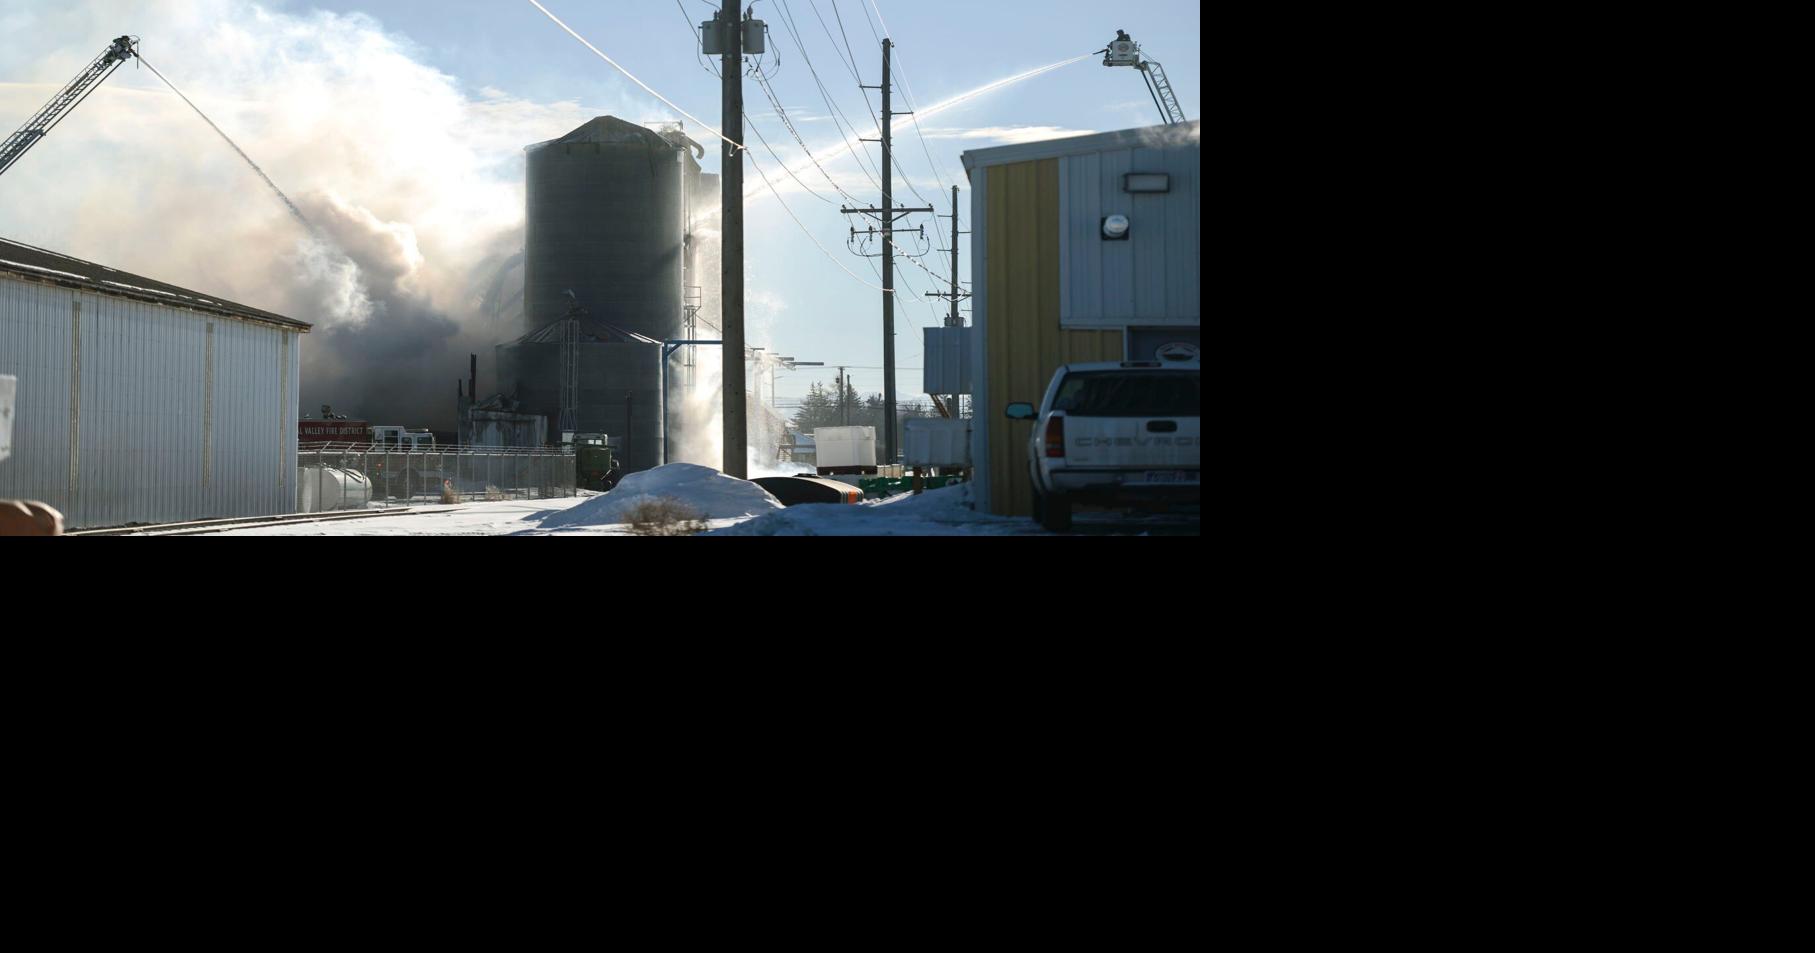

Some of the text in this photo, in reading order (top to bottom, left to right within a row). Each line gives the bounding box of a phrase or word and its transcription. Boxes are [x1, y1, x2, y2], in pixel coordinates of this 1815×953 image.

[304, 427, 325, 435] VALLEY
[326, 427, 338, 435] FIRE
[340, 427, 363, 435] DISTRICT
